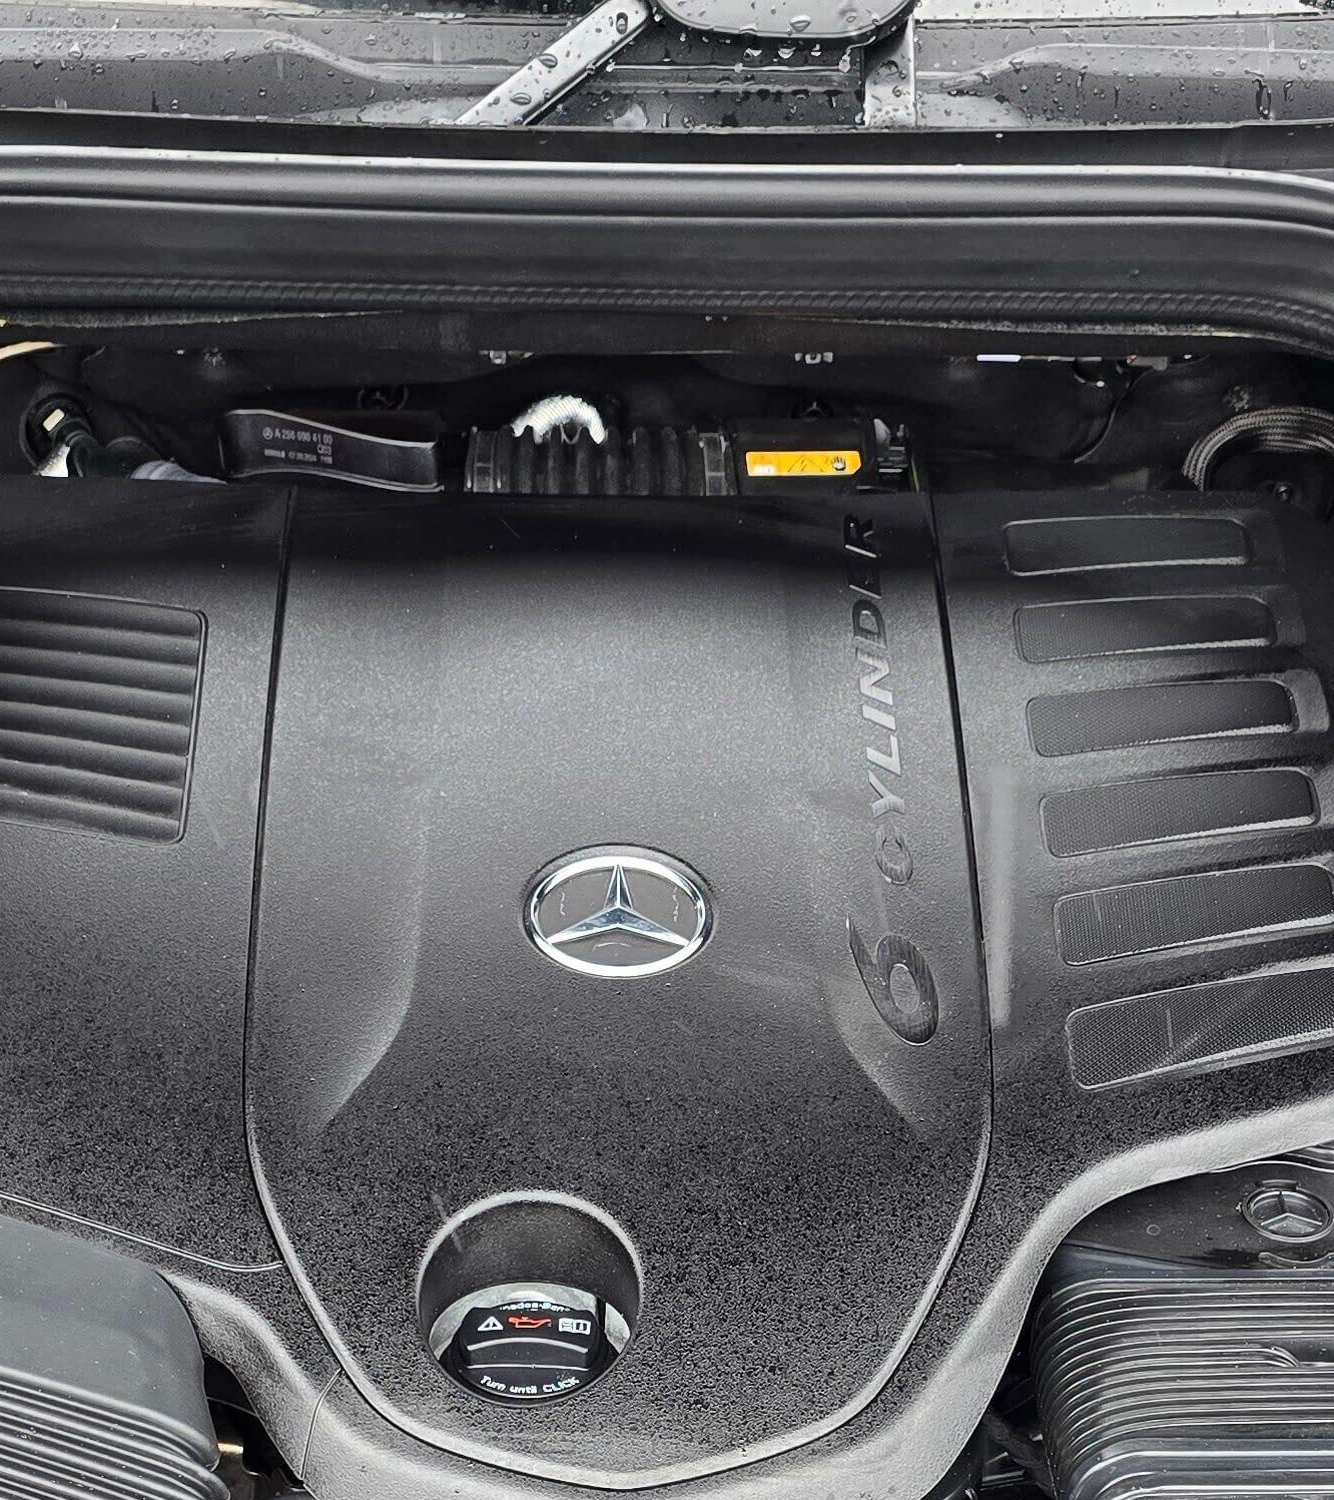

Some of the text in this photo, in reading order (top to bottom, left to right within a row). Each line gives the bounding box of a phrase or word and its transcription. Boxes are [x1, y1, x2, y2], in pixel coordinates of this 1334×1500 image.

[843, 513, 940, 1047] 6 CYLINDER
[480, 1375, 580, 1394] Turn until CLICK
